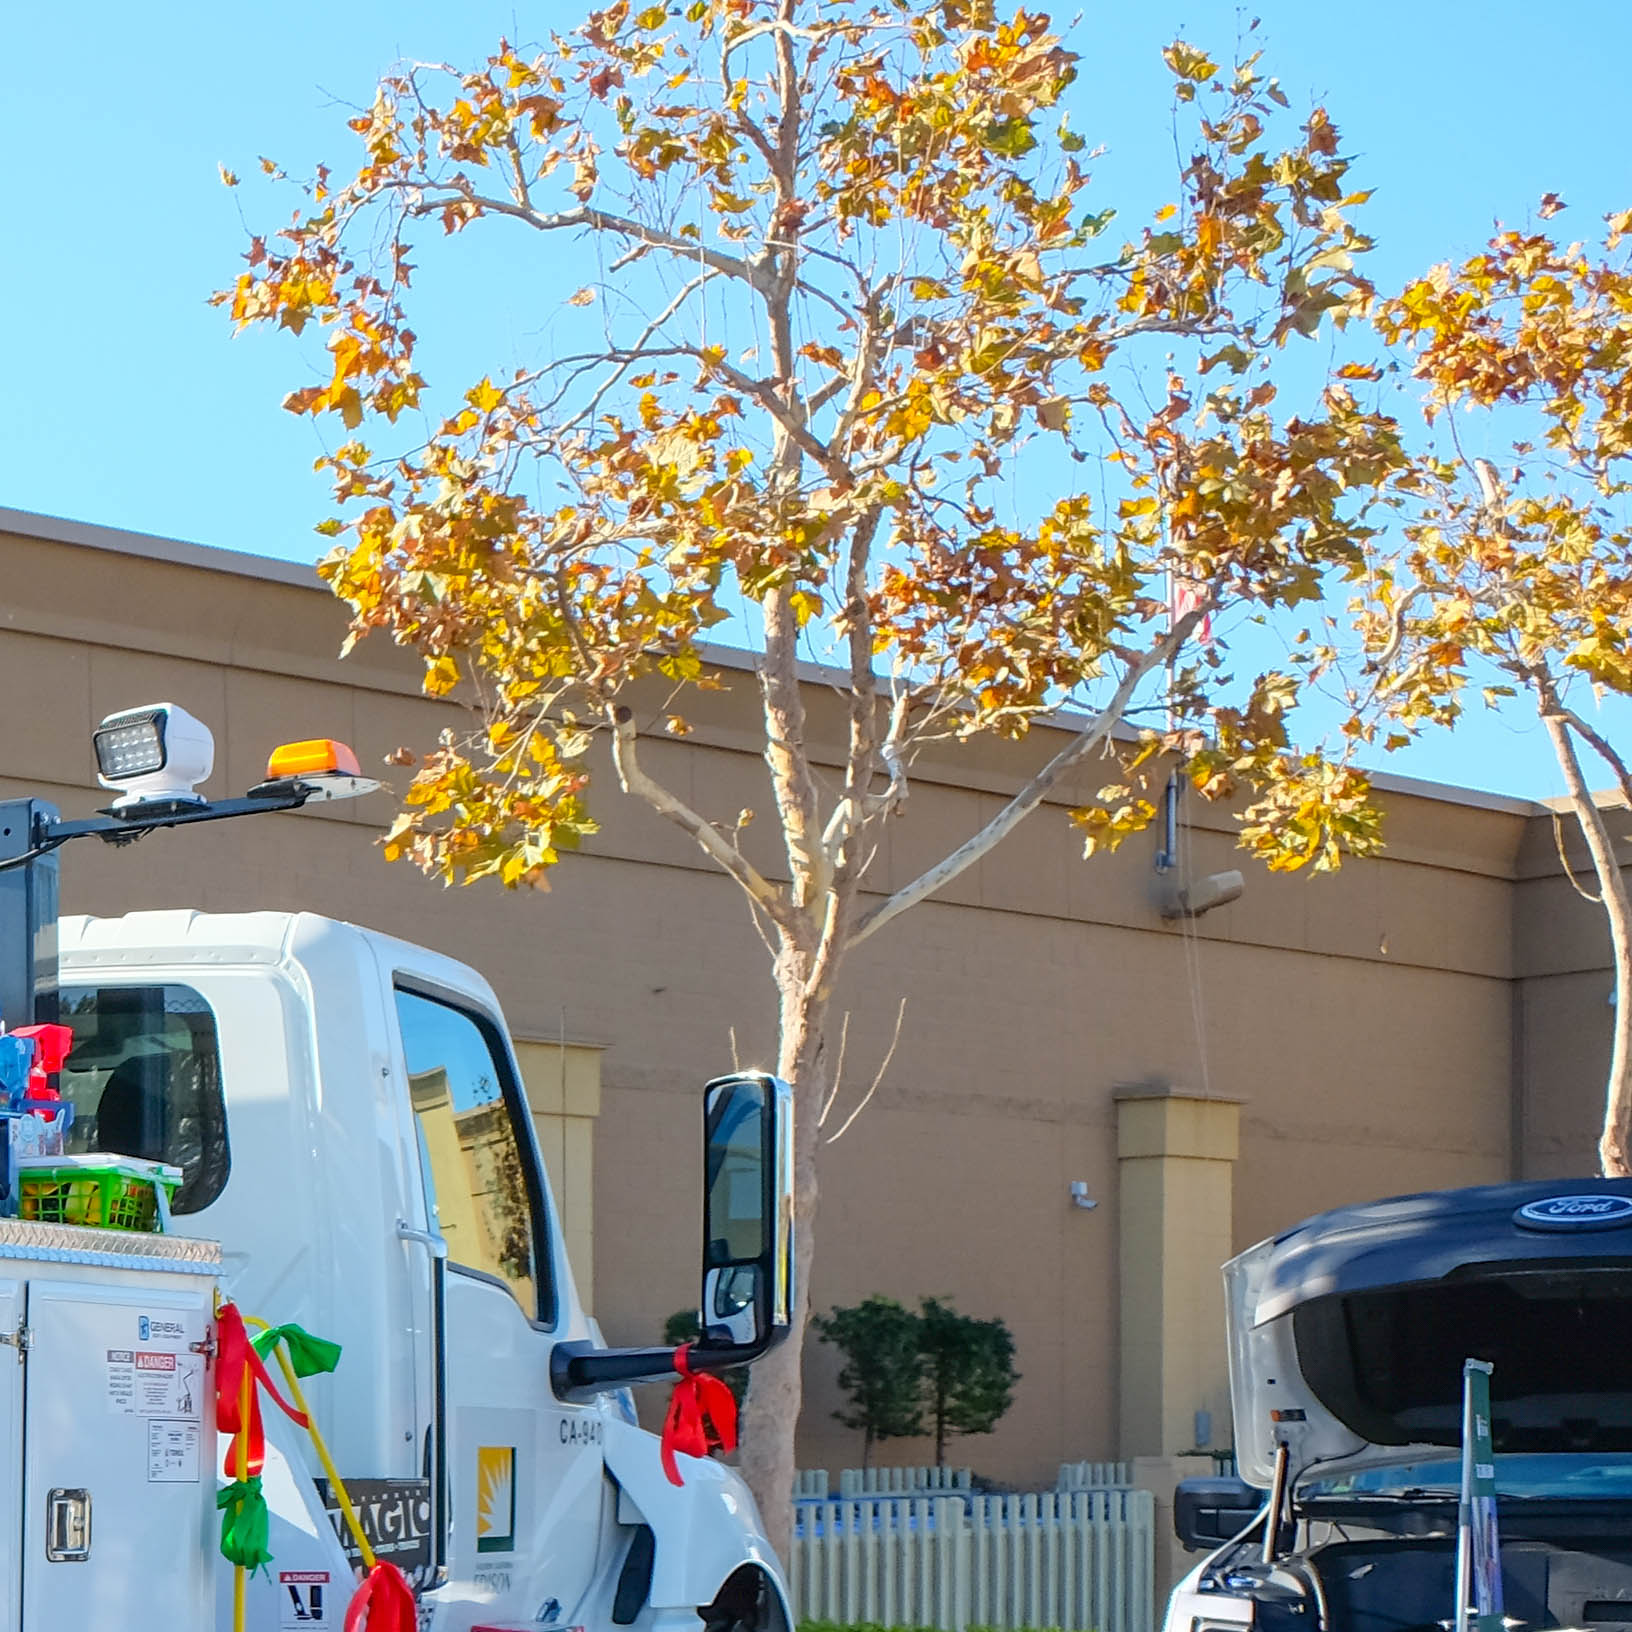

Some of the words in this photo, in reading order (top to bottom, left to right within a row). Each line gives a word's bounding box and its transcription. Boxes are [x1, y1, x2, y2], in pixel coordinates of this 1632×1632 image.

[1549, 1199, 1613, 1215] Ford
[151, 1321, 185, 1334] GENERAL
[291, 1573, 325, 1582] DANGER
